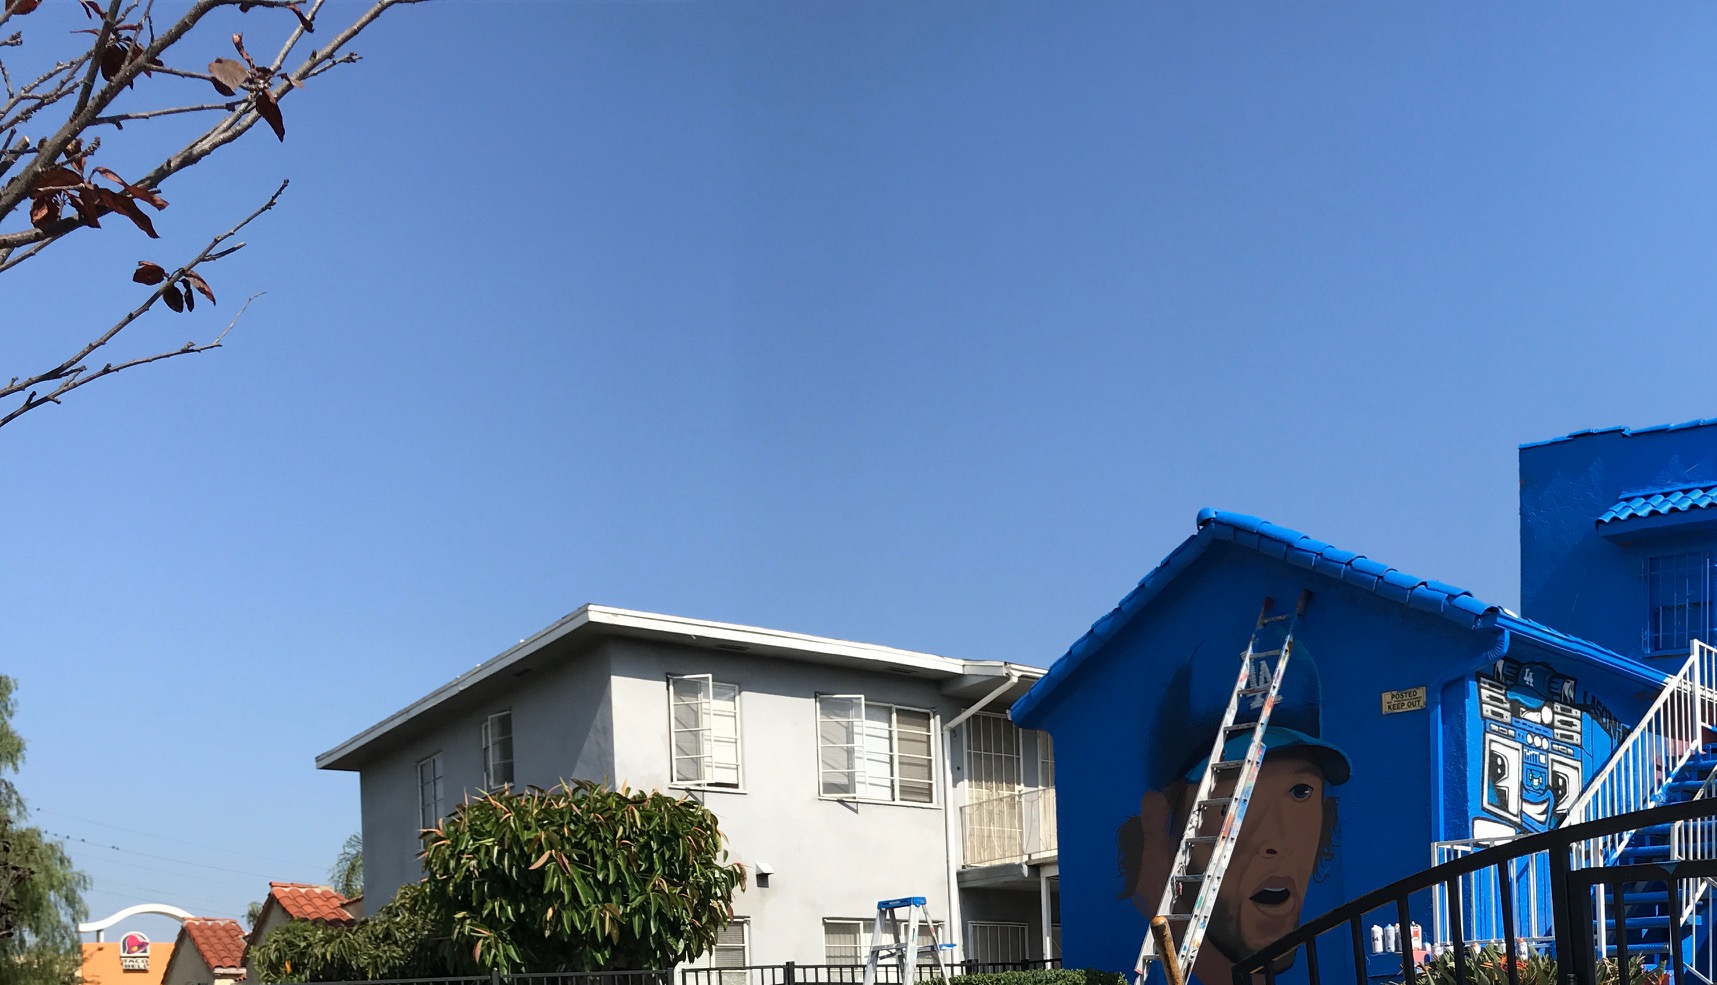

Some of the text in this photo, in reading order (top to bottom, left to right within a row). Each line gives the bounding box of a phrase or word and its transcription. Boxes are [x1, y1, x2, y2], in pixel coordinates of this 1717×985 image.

[1391, 690, 1418, 700] POSTED
[1387, 702, 1405, 711] KEEP
[1406, 699, 1421, 708] OUT
